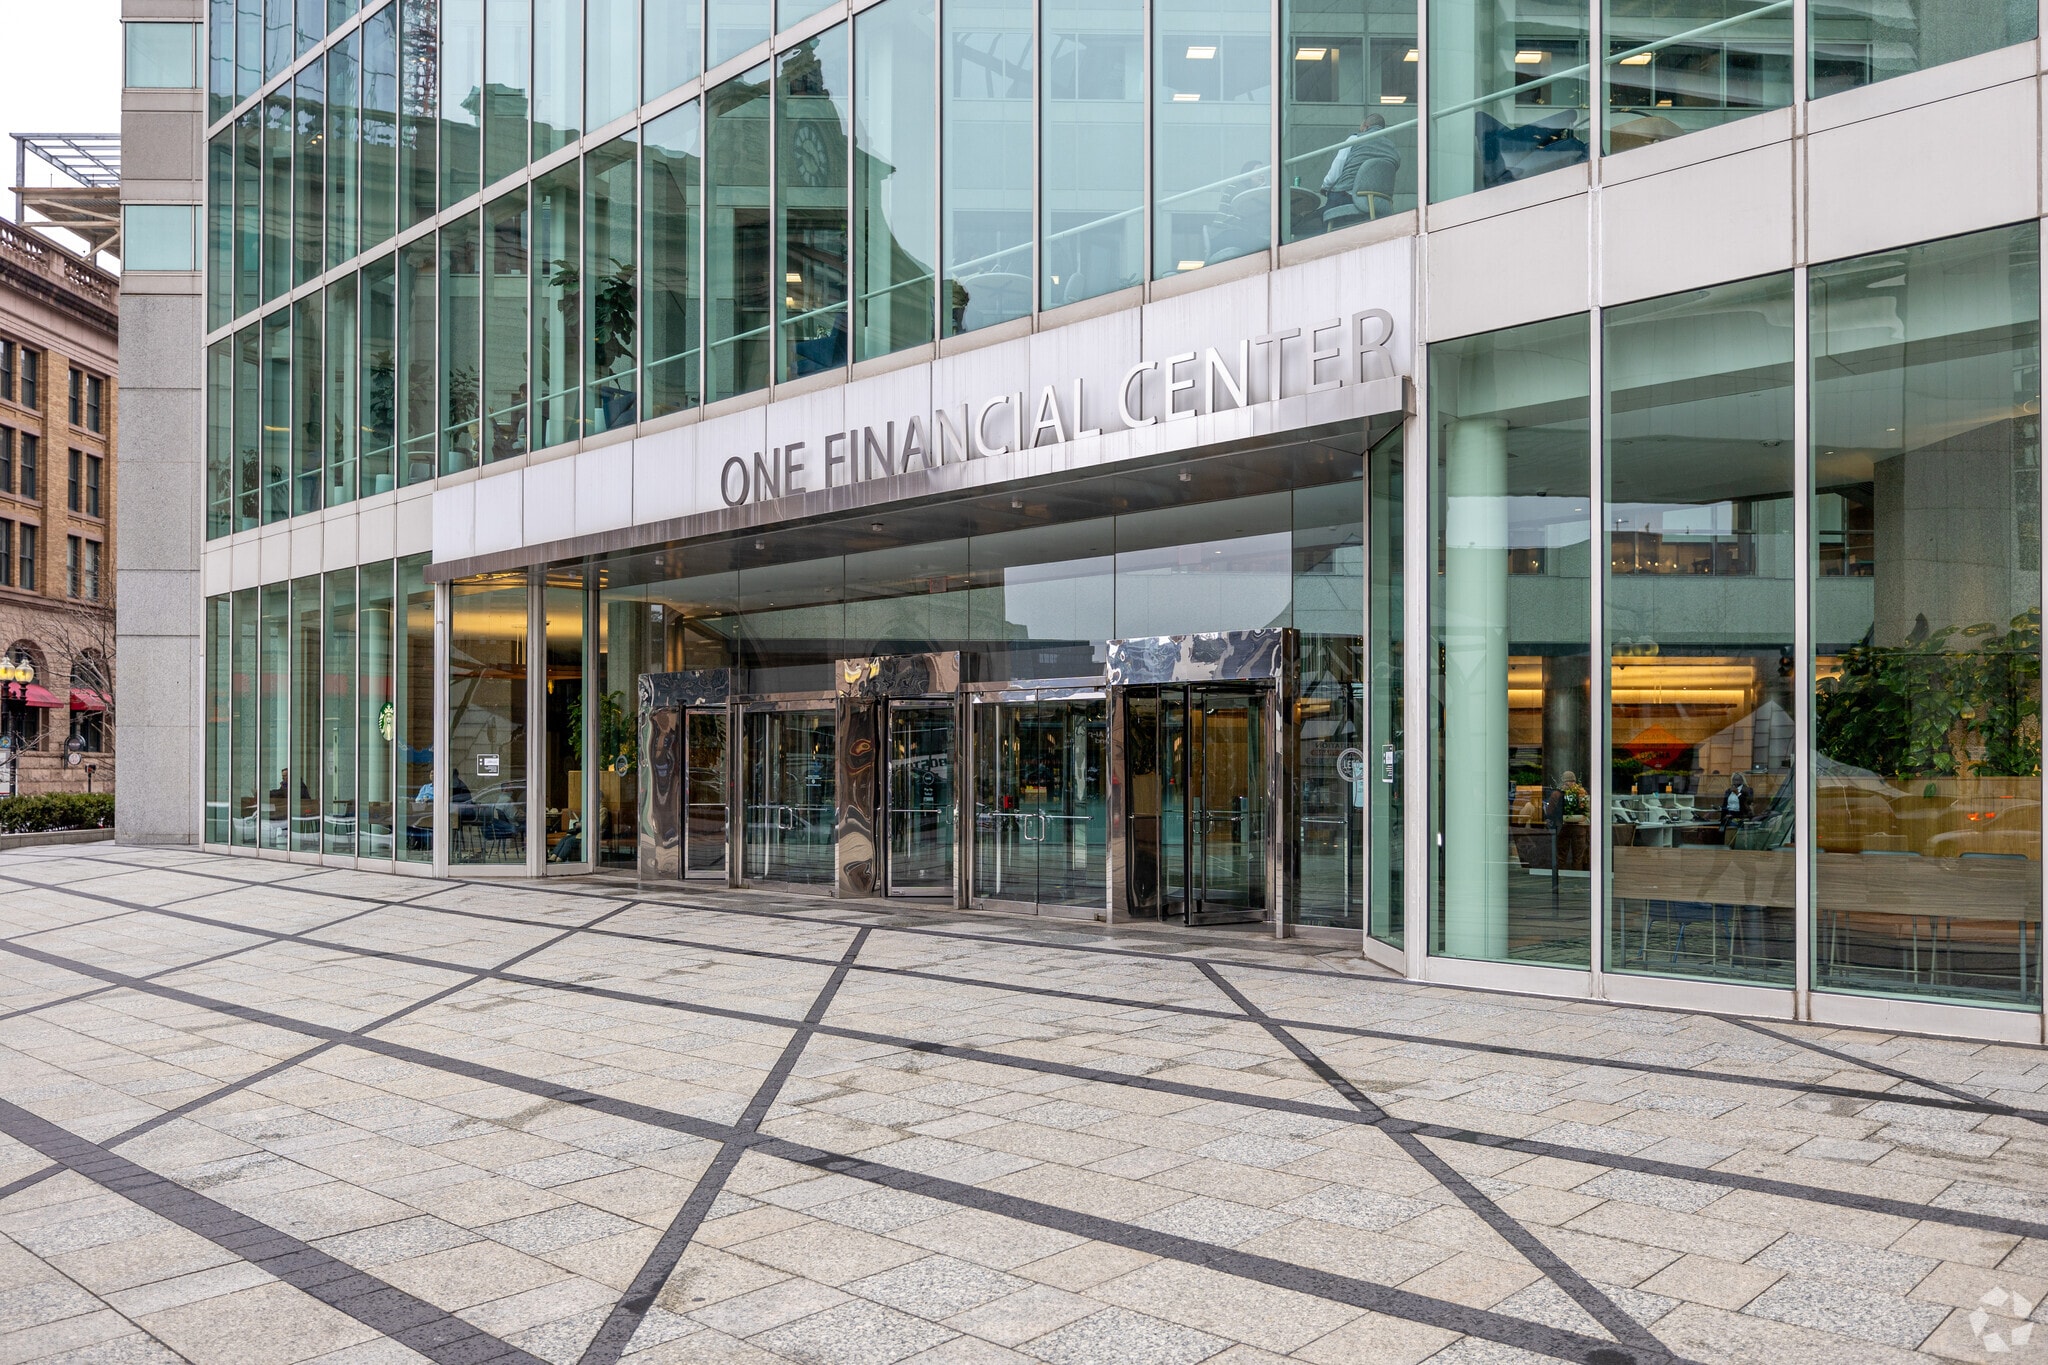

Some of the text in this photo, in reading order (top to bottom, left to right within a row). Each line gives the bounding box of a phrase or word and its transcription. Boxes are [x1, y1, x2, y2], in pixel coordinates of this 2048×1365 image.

[721, 308, 1397, 507] ONE FINANCIAL CENTER
